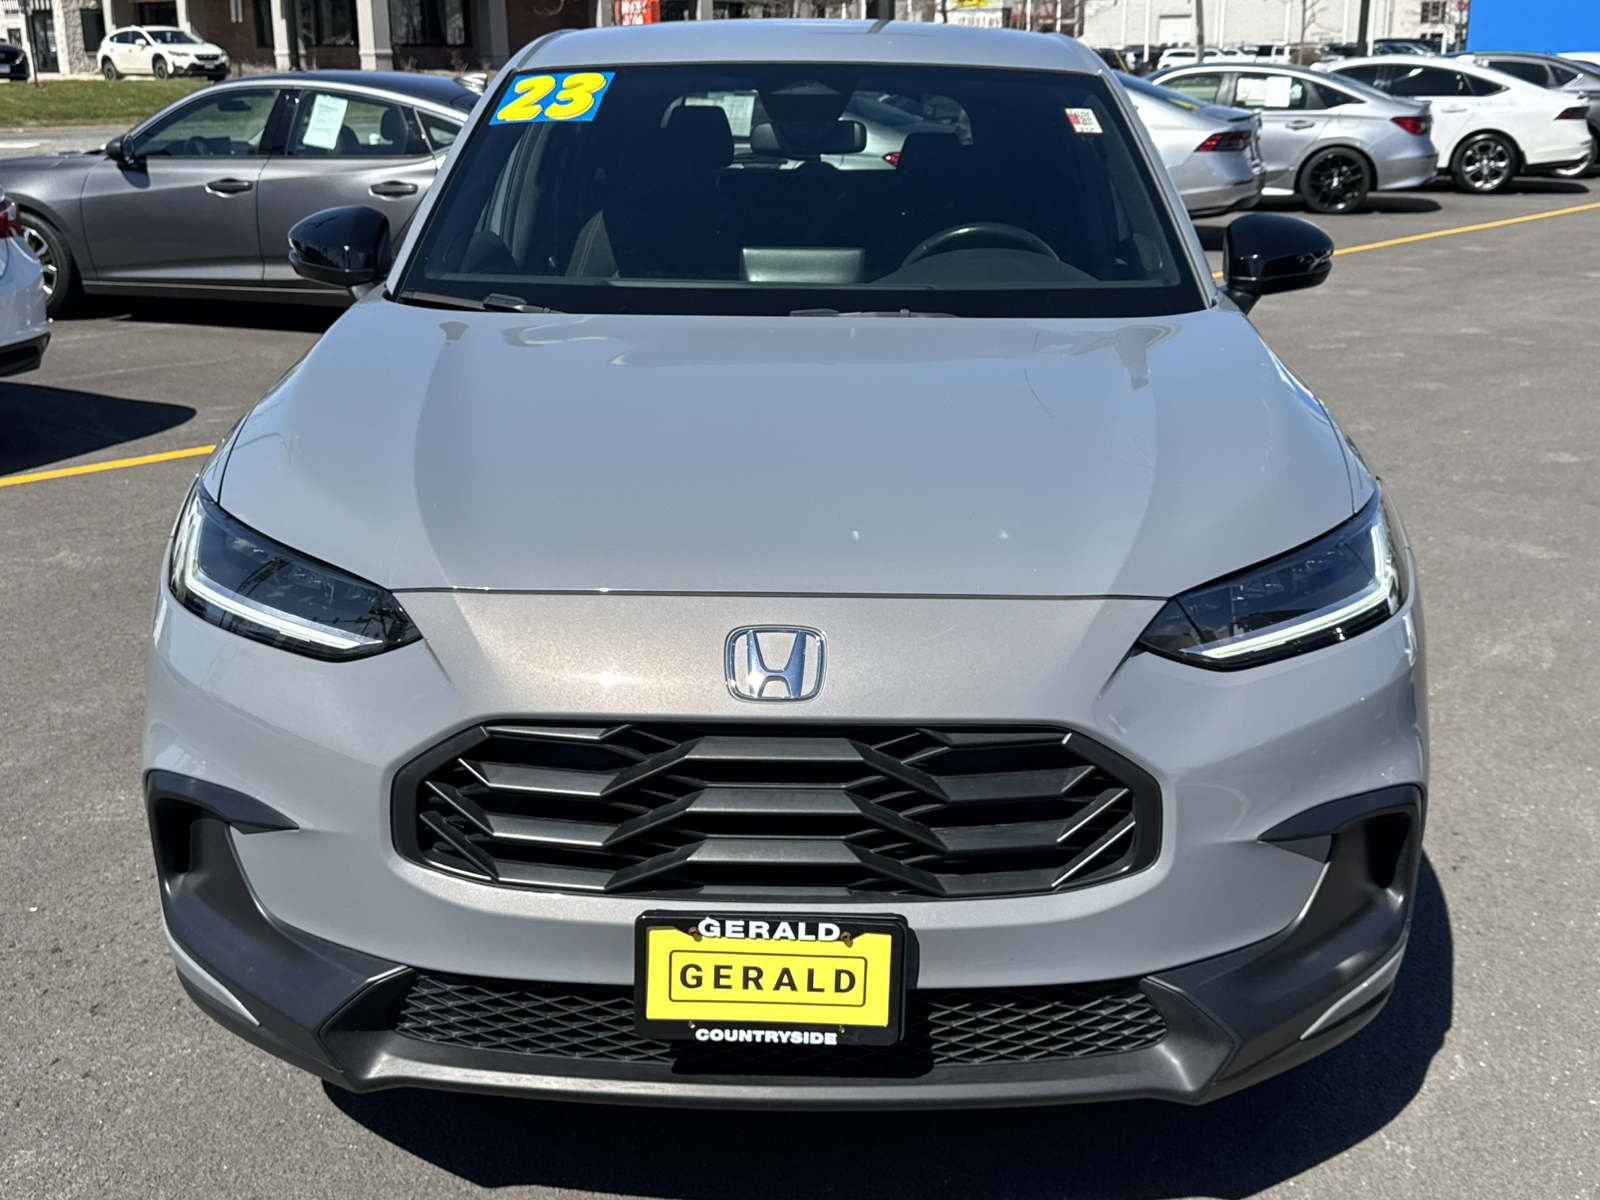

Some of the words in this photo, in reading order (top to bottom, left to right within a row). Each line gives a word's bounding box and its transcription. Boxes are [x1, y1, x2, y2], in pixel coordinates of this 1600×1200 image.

[496, 72, 607, 122] 23
[698, 917, 841, 942] GERALD
[679, 963, 857, 993] GERALD
[695, 1028, 838, 1046] COUNTRYSIDE
